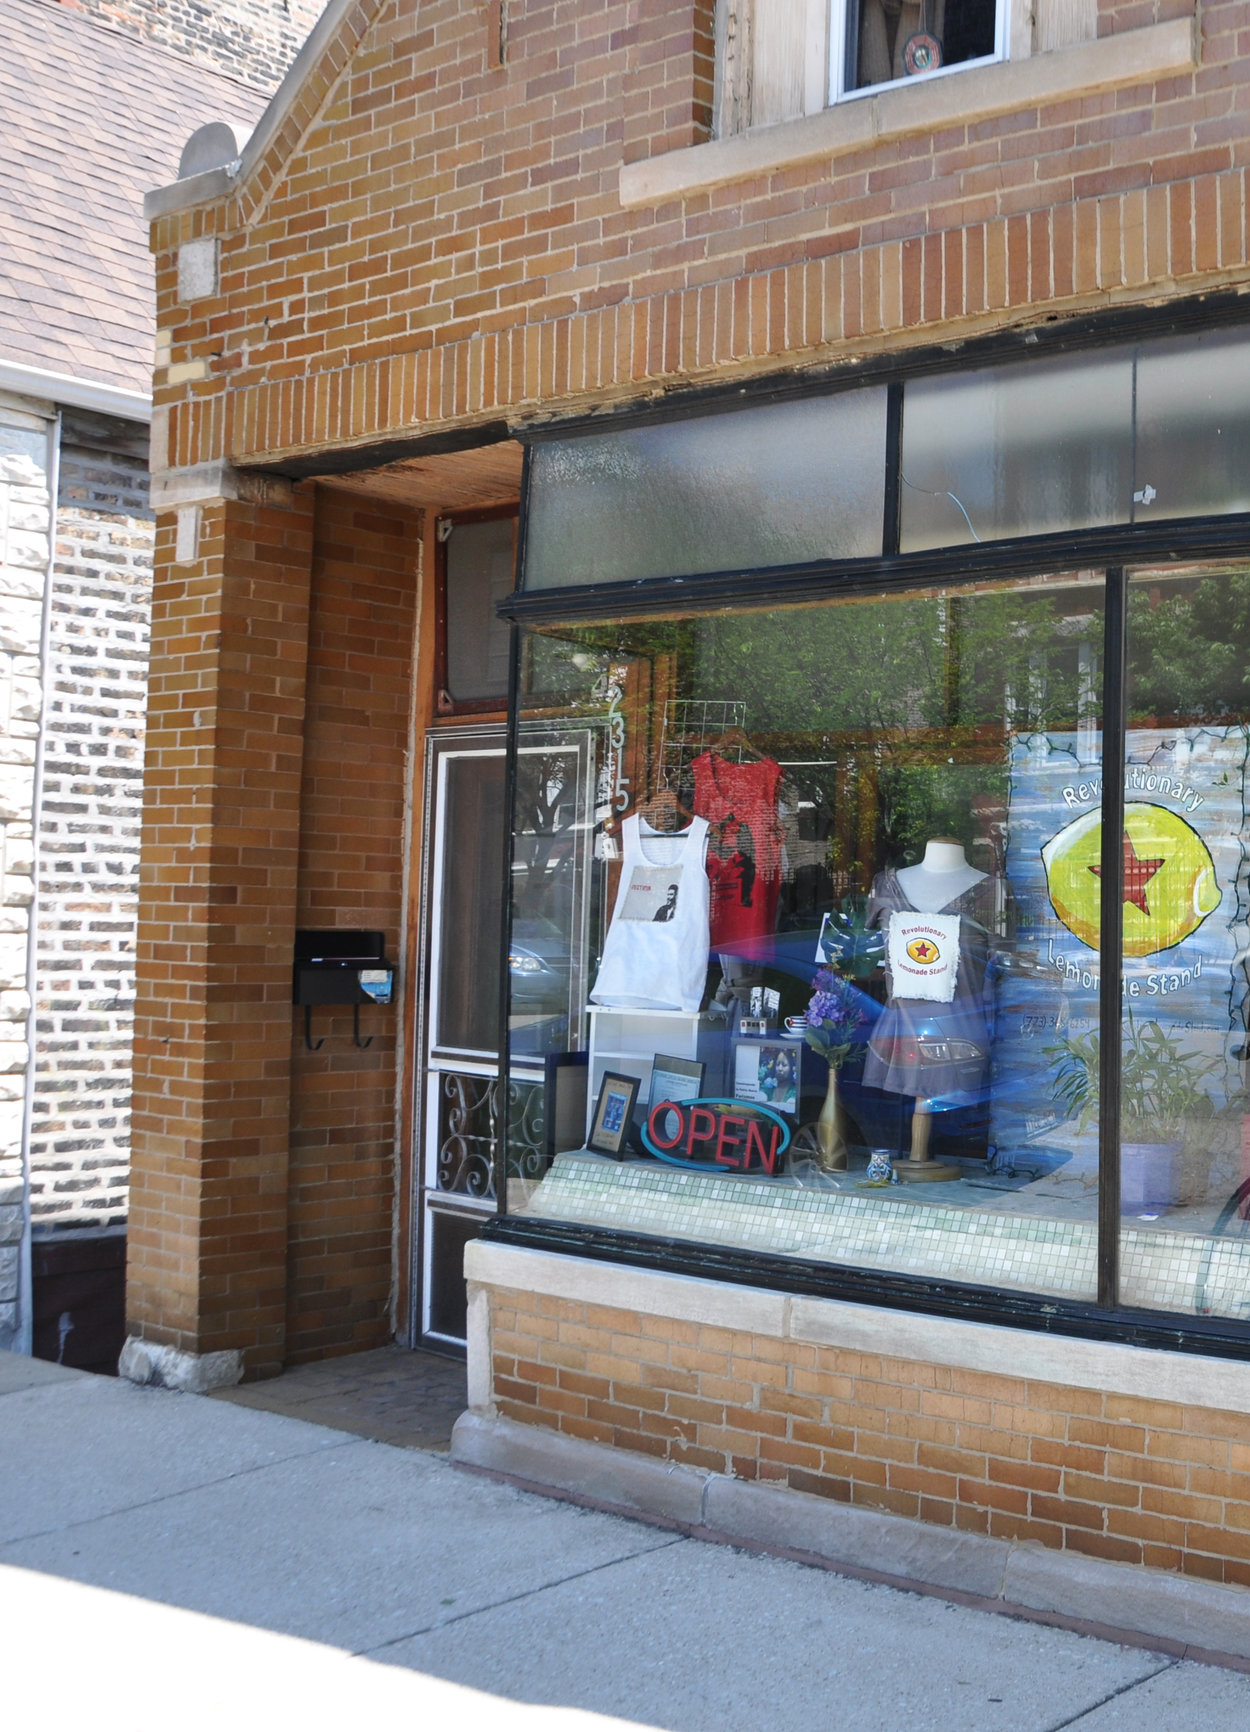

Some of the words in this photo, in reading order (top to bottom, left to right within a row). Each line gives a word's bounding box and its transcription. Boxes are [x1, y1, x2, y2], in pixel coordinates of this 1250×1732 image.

[1062, 767, 1205, 812] Revtionary
[901, 925, 947, 941] Revolutionary
[897, 959, 928, 976] Lemonade
[929, 962, 948, 976] Stand
[1047, 938, 1140, 997] Lemonde
[1146, 953, 1203, 996] Stand
[648, 1101, 779, 1174] OPEN
